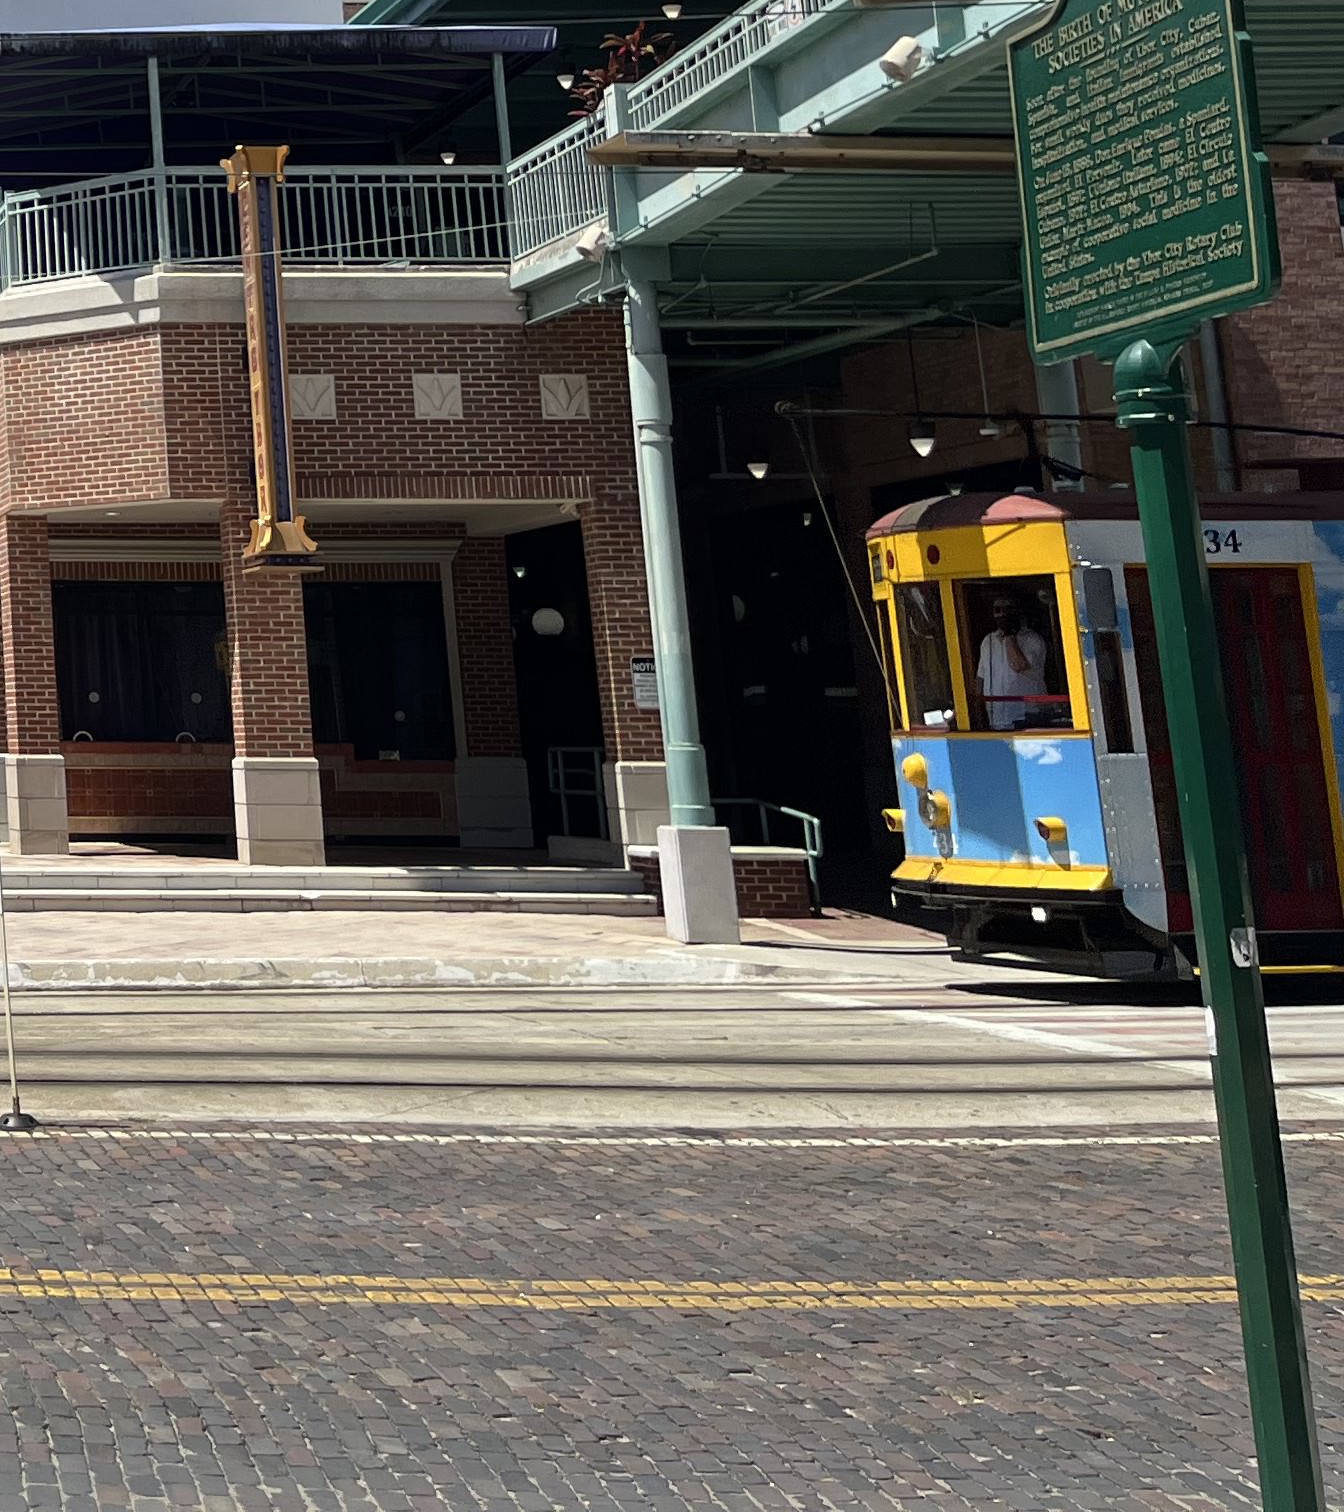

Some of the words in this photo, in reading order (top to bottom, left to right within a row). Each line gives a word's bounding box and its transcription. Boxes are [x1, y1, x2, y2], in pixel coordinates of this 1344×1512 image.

[1031, 33, 1053, 58] THE
[1058, 13, 1091, 45] BIRTH
[1096, 3, 1112, 25] OF
[1048, 30, 1105, 73] SOCIETIES
[1109, 22, 1121, 43] IN
[1123, 50, 1133, 63] of
[1136, 39, 1156, 57] Ybor
[1160, 26, 1184, 48] City,
[1115, 100, 1134, 117] they
[1137, 81, 1175, 106] received
[1185, 129, 1195, 141] El
[1199, 115, 1231, 135] Centro
[1186, 145, 1197, 158] El
[1148, 191, 1168, 206] This
[1173, 186, 1180, 197] is
[1206, 164, 1236, 184] oldest
[1089, 201, 1100, 212] El
[1132, 211, 1157, 229] social
[1141, 249, 1162, 264] Ybor
[1163, 242, 1183, 259] City
[1185, 230, 1218, 253] Rotary
[1219, 221, 1242, 238] Club
[1206, 239, 1243, 263] Society
[1203, 529, 1242, 554] 34
[632, 662, 656, 672] NOTI
